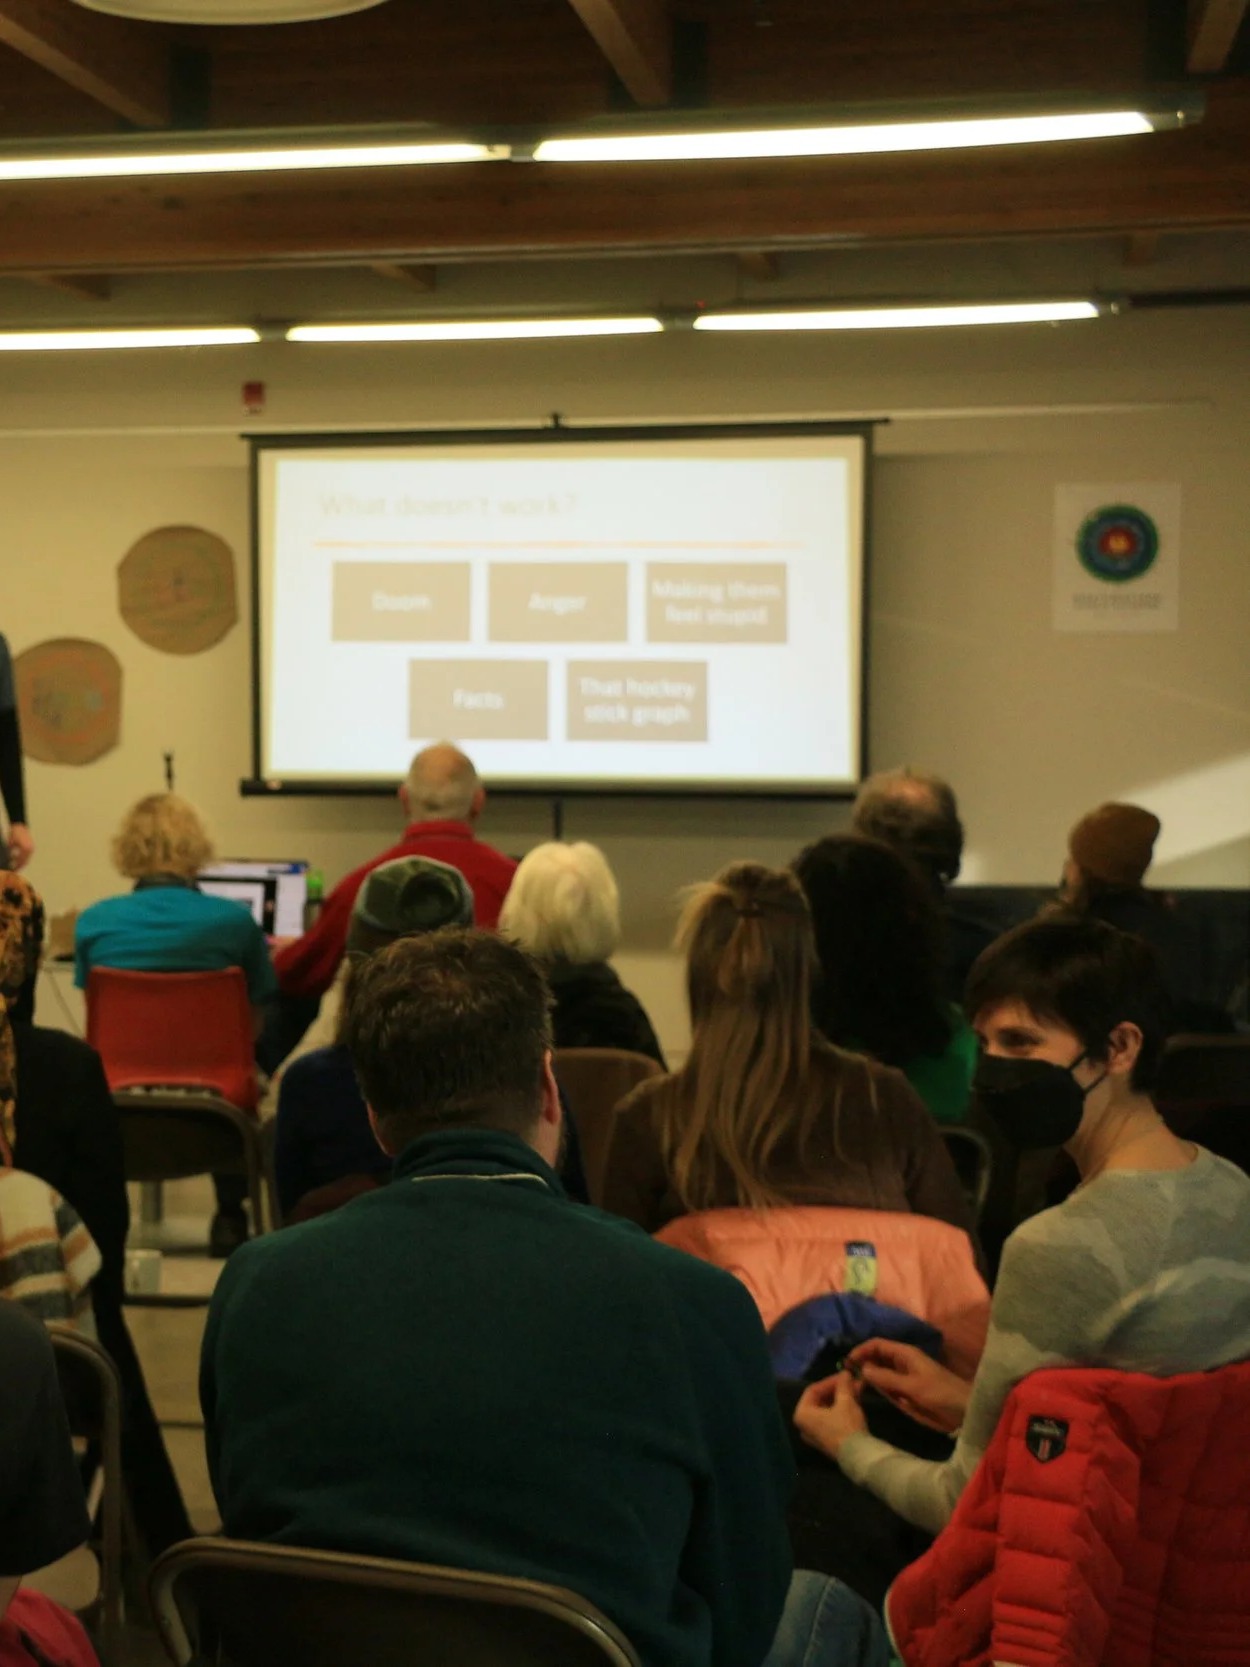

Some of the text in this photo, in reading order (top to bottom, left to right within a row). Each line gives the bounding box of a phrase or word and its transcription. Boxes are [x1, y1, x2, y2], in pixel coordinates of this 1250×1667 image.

[320, 491, 579, 518] What doesn't work?
[371, 588, 432, 612] Doom
[652, 578, 782, 603] Making them
[528, 592, 587, 615] Anger
[665, 603, 768, 627] feel stupid
[453, 687, 505, 711] Facts
[579, 676, 695, 701] That hockey
[583, 701, 691, 727] stick graph
